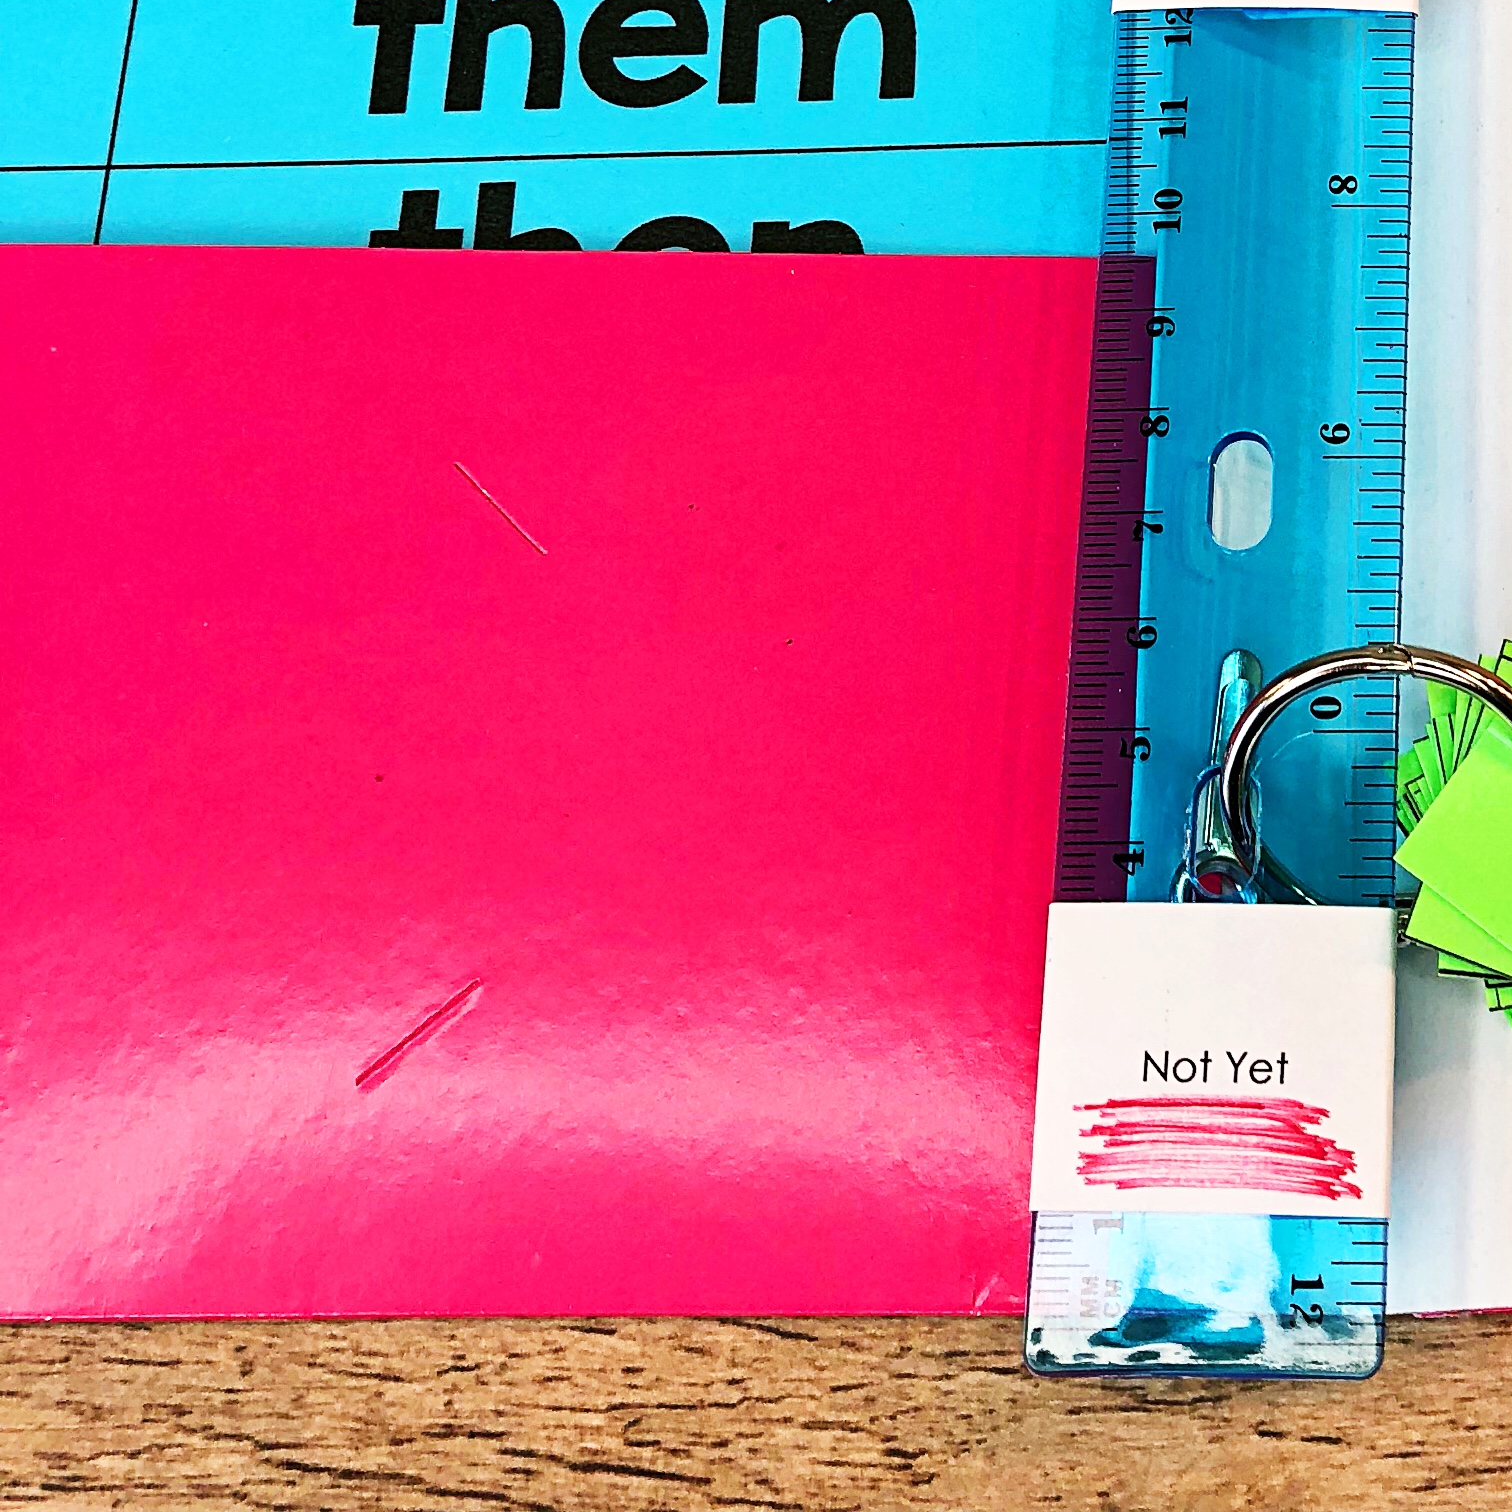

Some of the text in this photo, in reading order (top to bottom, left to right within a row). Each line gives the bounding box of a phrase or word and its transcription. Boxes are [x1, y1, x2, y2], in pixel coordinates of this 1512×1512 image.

[1158, 96, 1189, 140] 11
[1328, 174, 1358, 195] 8
[1152, 188, 1183, 235] 10
[1139, 413, 1171, 438] 8
[1120, 735, 1152, 763] 5
[1112, 848, 1147, 877] 4
[1143, 1051, 1288, 1084] Not Yet
[1290, 1273, 1325, 1329] 12
